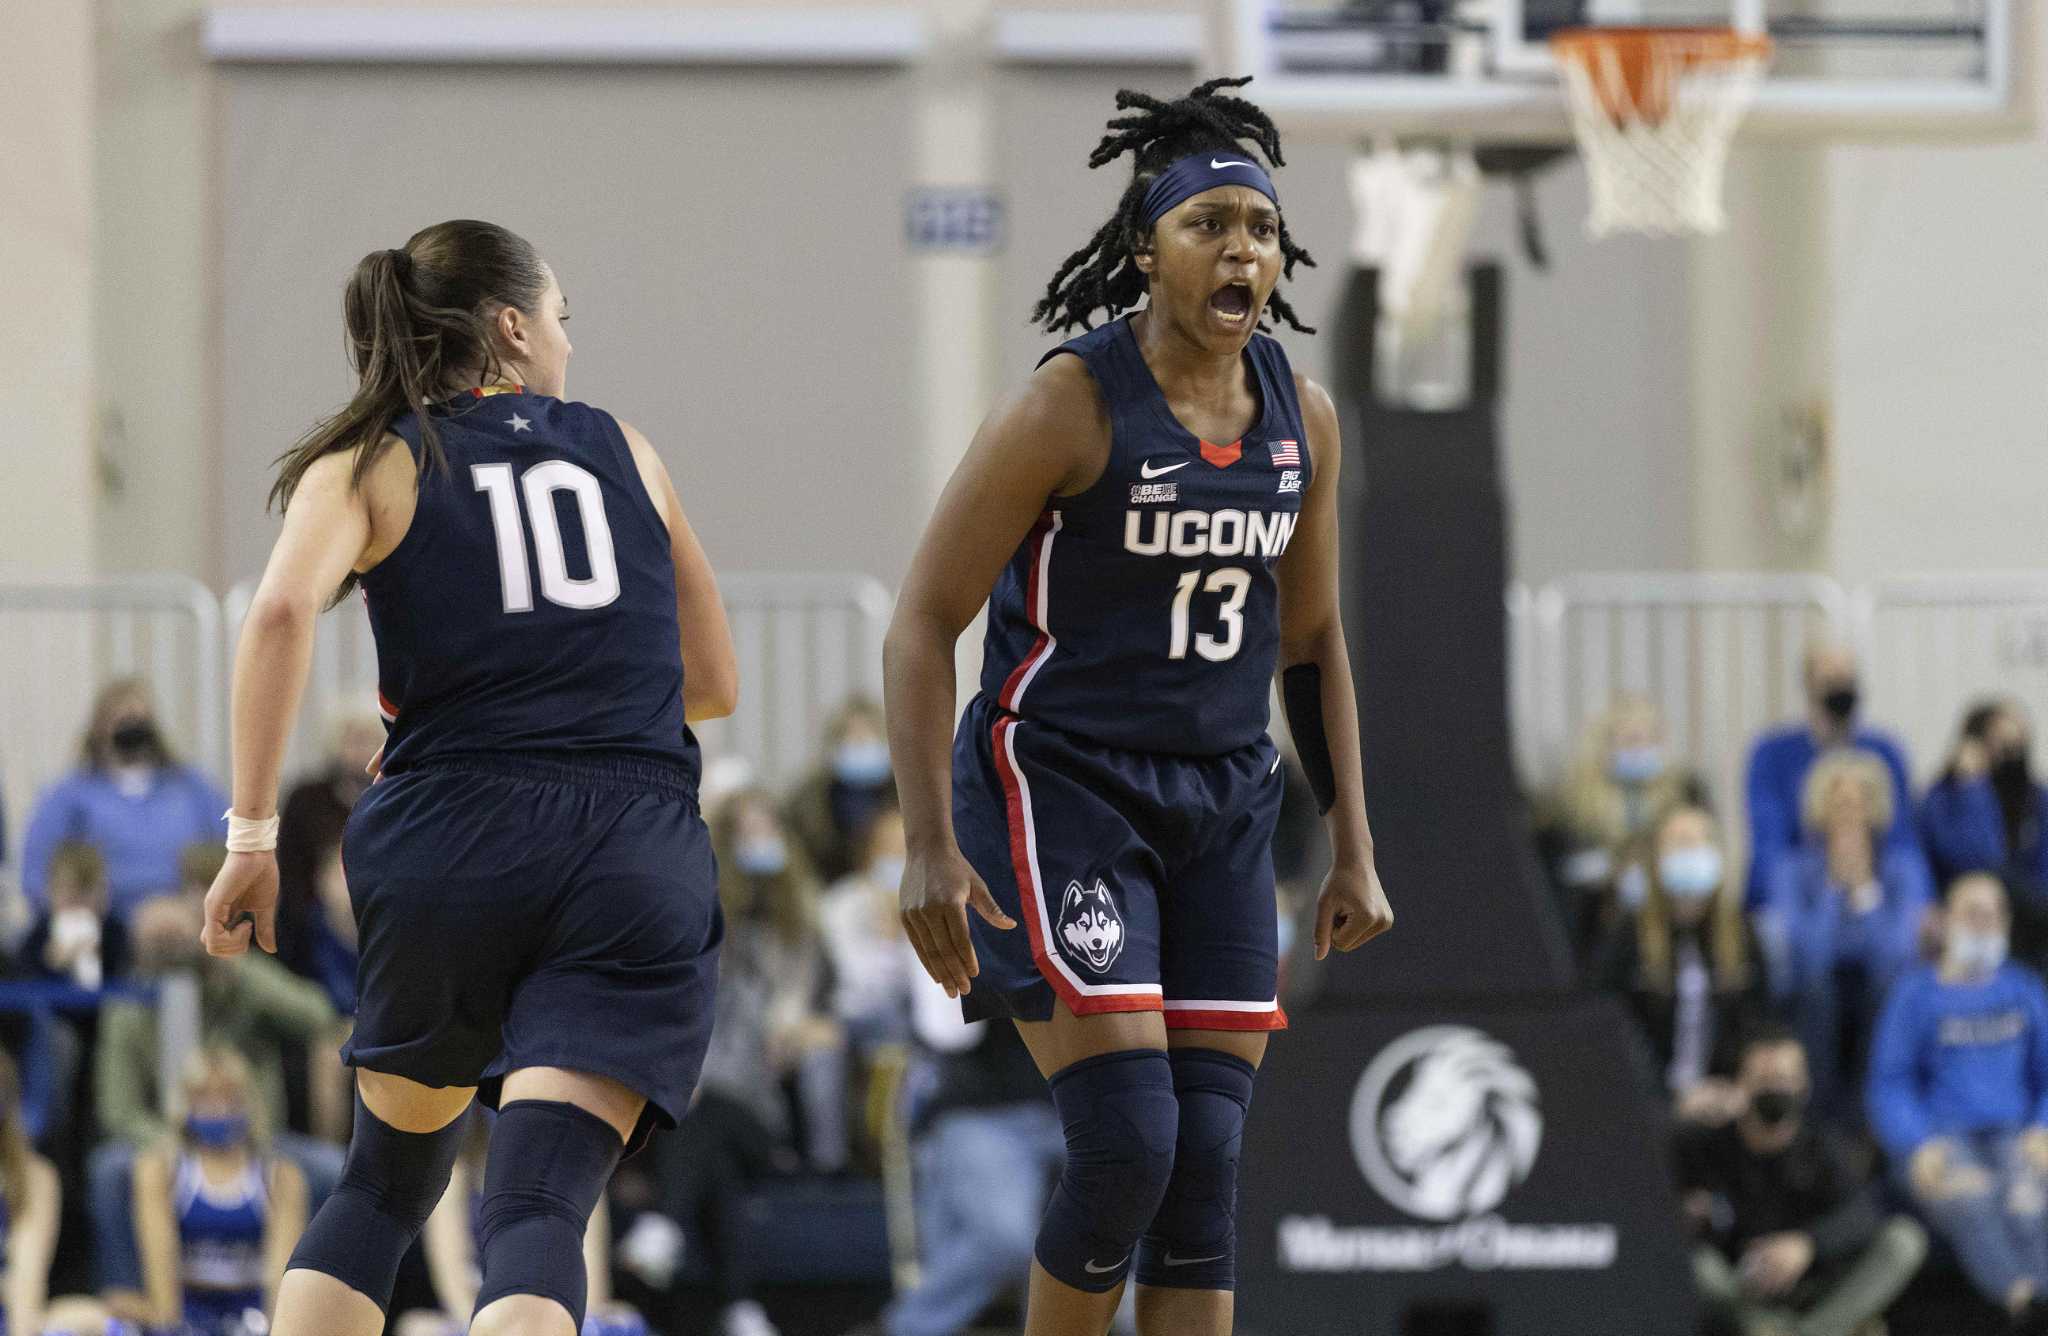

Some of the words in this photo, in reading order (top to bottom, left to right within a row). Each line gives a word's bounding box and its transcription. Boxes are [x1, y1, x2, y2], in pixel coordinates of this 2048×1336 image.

[1279, 480, 1302, 489] EAST
[1281, 470, 1300, 480] BIG
[1131, 494, 1177, 504] CHANGE
[470, 460, 621, 613] 10
[1124, 509, 1299, 557] UCONN
[1168, 567, 1252, 661] 13
